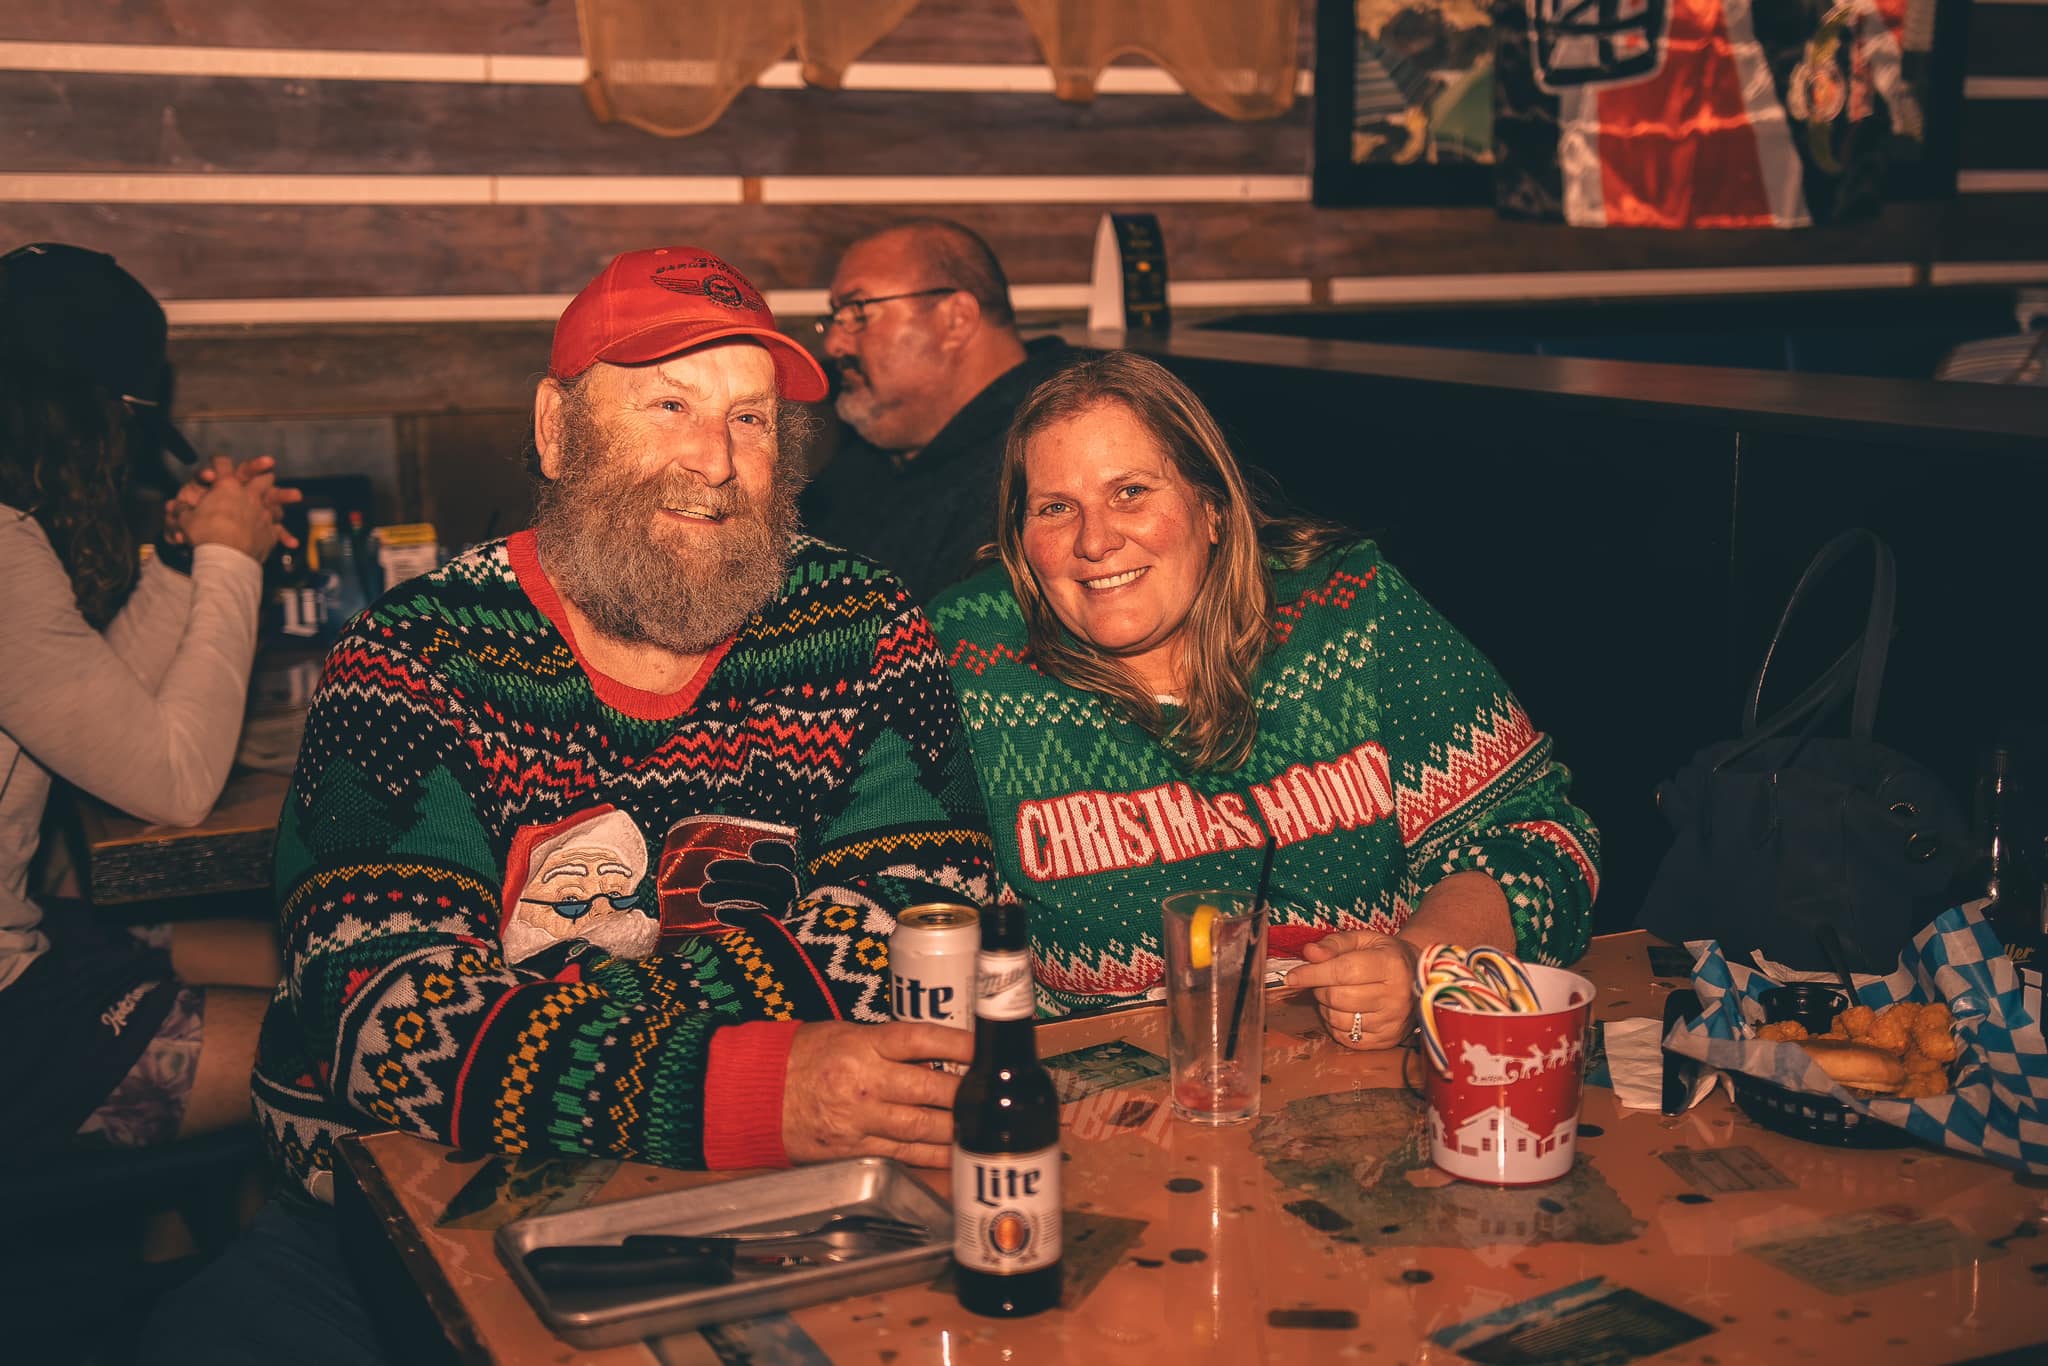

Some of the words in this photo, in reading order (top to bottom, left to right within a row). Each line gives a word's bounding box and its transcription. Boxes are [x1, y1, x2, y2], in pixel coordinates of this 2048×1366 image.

[1017, 782, 1264, 881] CHRISTMAS
[2004, 943, 2035, 963] ller
[974, 1164, 1041, 1208] Lite
